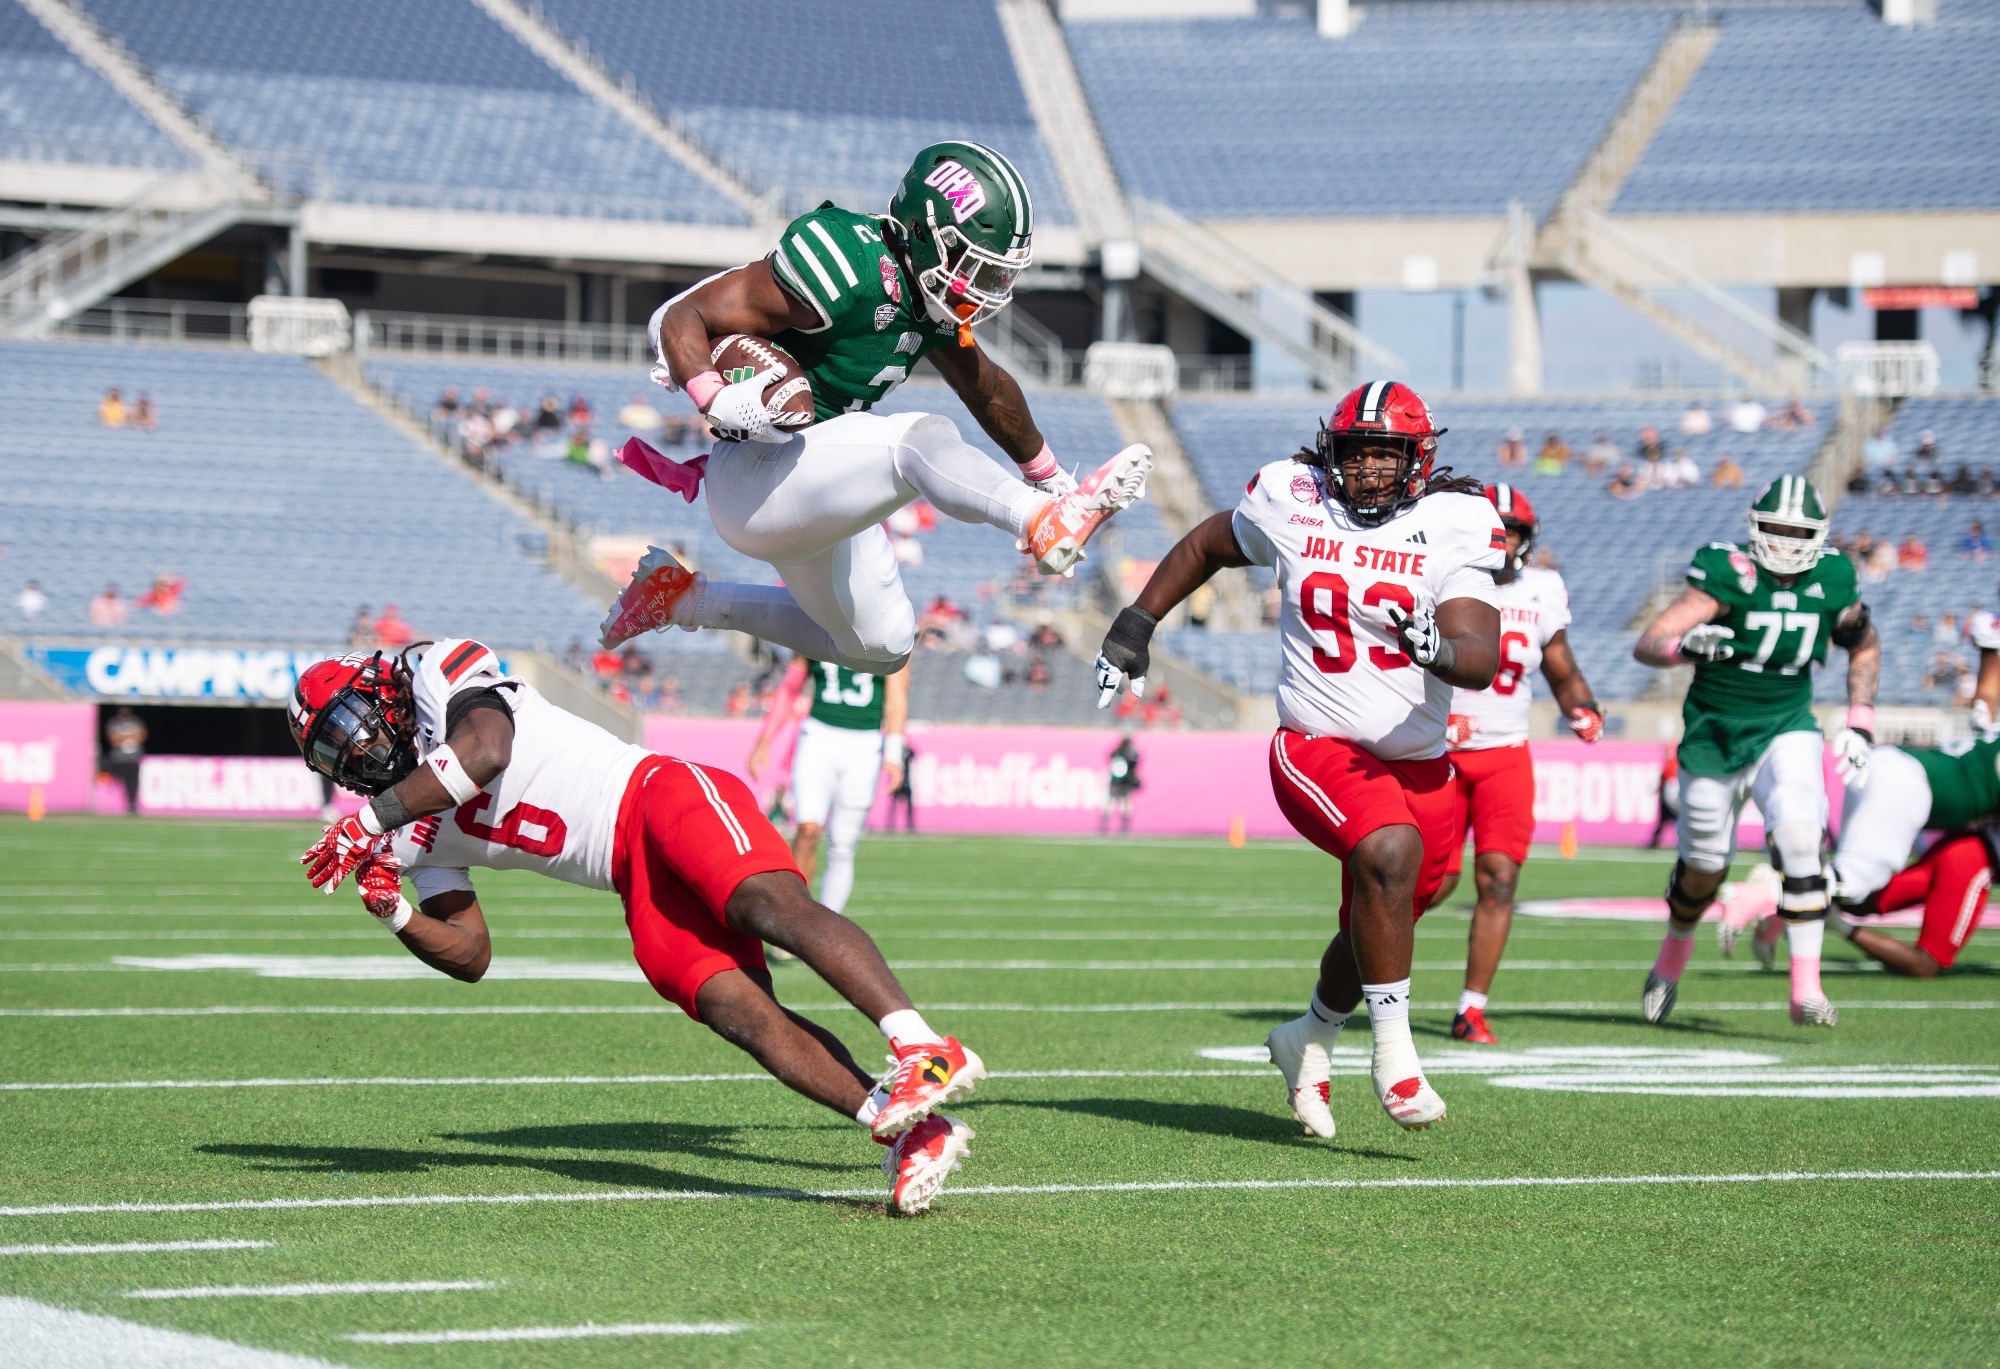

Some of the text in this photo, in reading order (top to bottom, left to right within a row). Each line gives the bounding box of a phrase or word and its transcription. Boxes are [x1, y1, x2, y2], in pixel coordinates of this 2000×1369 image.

[1301, 536, 1426, 577] JAX STATE
[1300, 571, 1415, 673] 93
[1739, 611, 1820, 675] 77
[86, 646, 292, 699] CAMPING
[819, 661, 875, 707] 13
[1492, 631, 1528, 695] 6
[139, 761, 323, 810] ORLAND
[454, 791, 567, 857] 6
